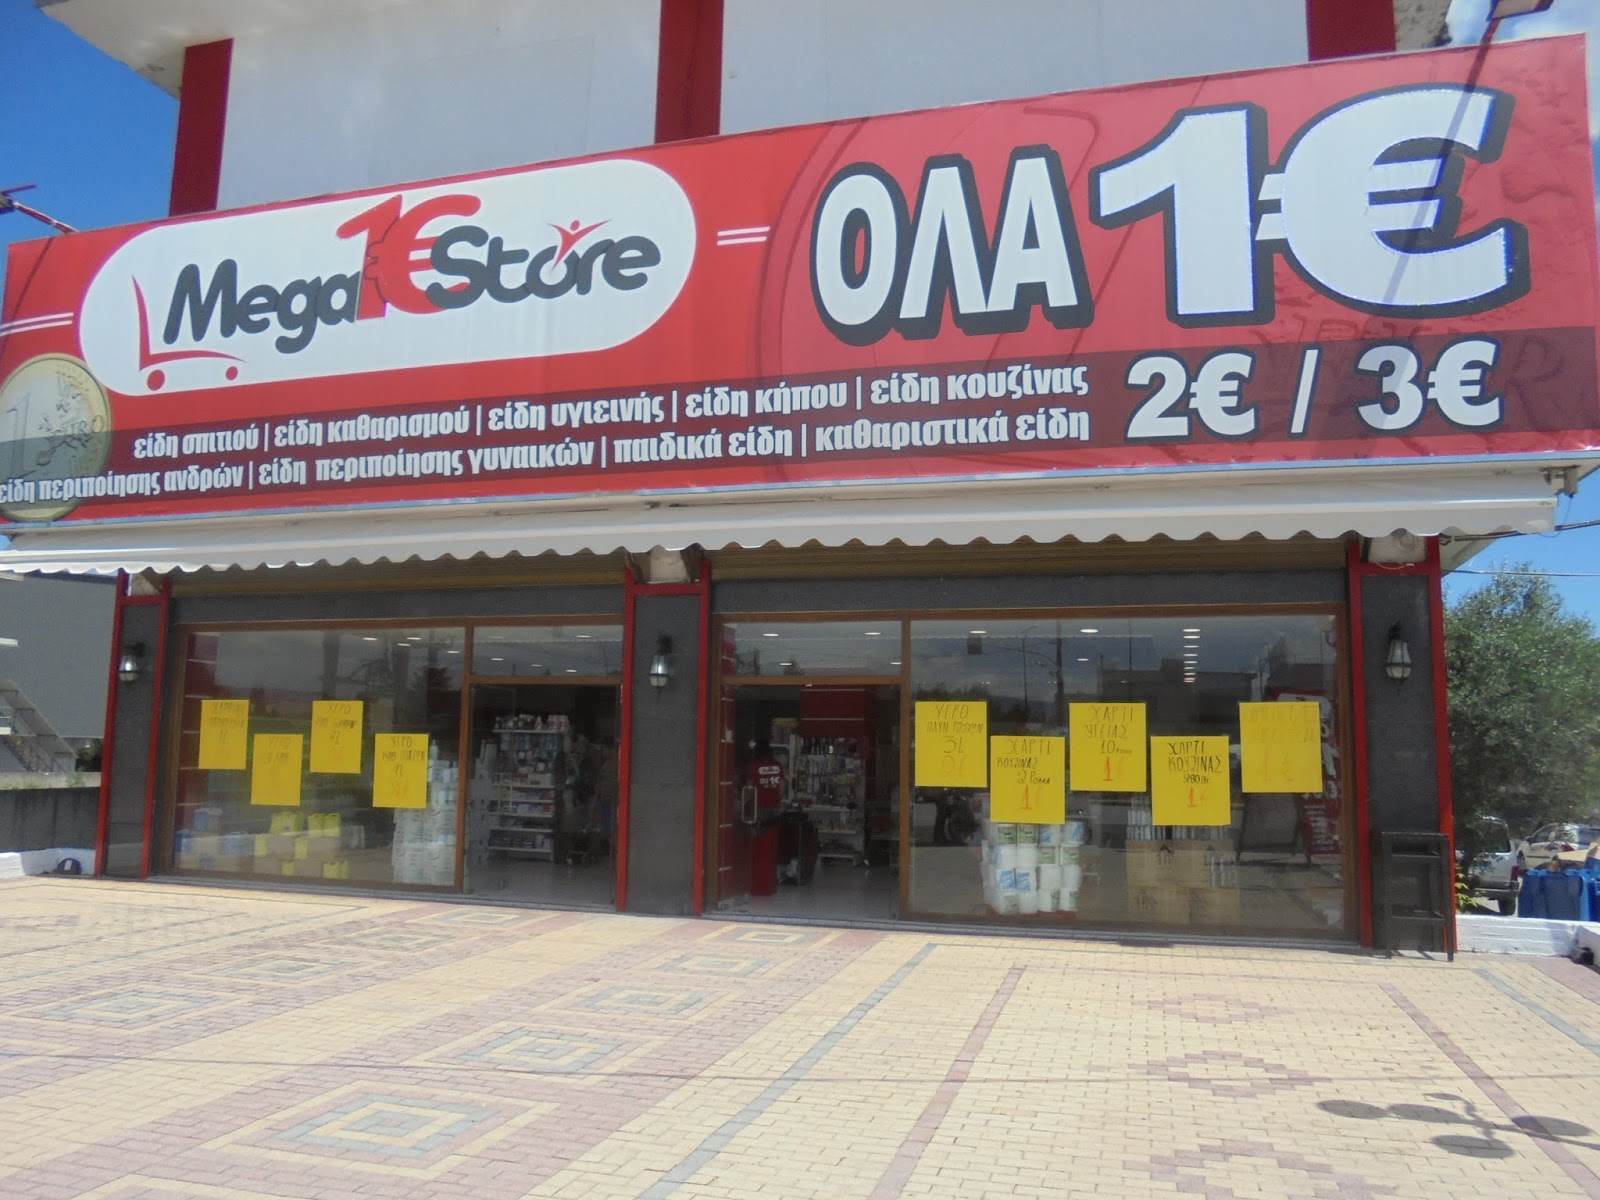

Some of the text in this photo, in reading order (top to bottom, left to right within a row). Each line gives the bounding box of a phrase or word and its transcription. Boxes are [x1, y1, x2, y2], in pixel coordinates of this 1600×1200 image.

[813, 86, 1513, 334] ΟΛΑ 1€
[163, 259, 361, 354] Mega
[426, 224, 661, 310] Store
[685, 381, 848, 418] είδη κήπου
[870, 363, 1089, 405] είδη κουζίνας
[1126, 351, 1256, 440] 2€
[1356, 340, 1501, 431] 3€
[274, 405, 470, 447] είδη καθαρισμού
[487, 391, 665, 431] είδη υγιεινής
[815, 407, 1090, 452] καθαριστικά είδη
[133, 423, 259, 459] είδη σπιτιού
[258, 437, 595, 485] είδη περιποίησης γυναικών
[613, 425, 793, 463] παιδικά είδη
[0, 462, 244, 504] είδη περιποίησης ανδρών
[935, 703, 969, 720] ΥΓΡΟ
[1089, 706, 1134, 722] ΧΑΡΤΙ
[1006, 738, 1051, 755] ΧΑΡΤΙ
[1167, 740, 1205, 755] ΧΑΡΤΙ
